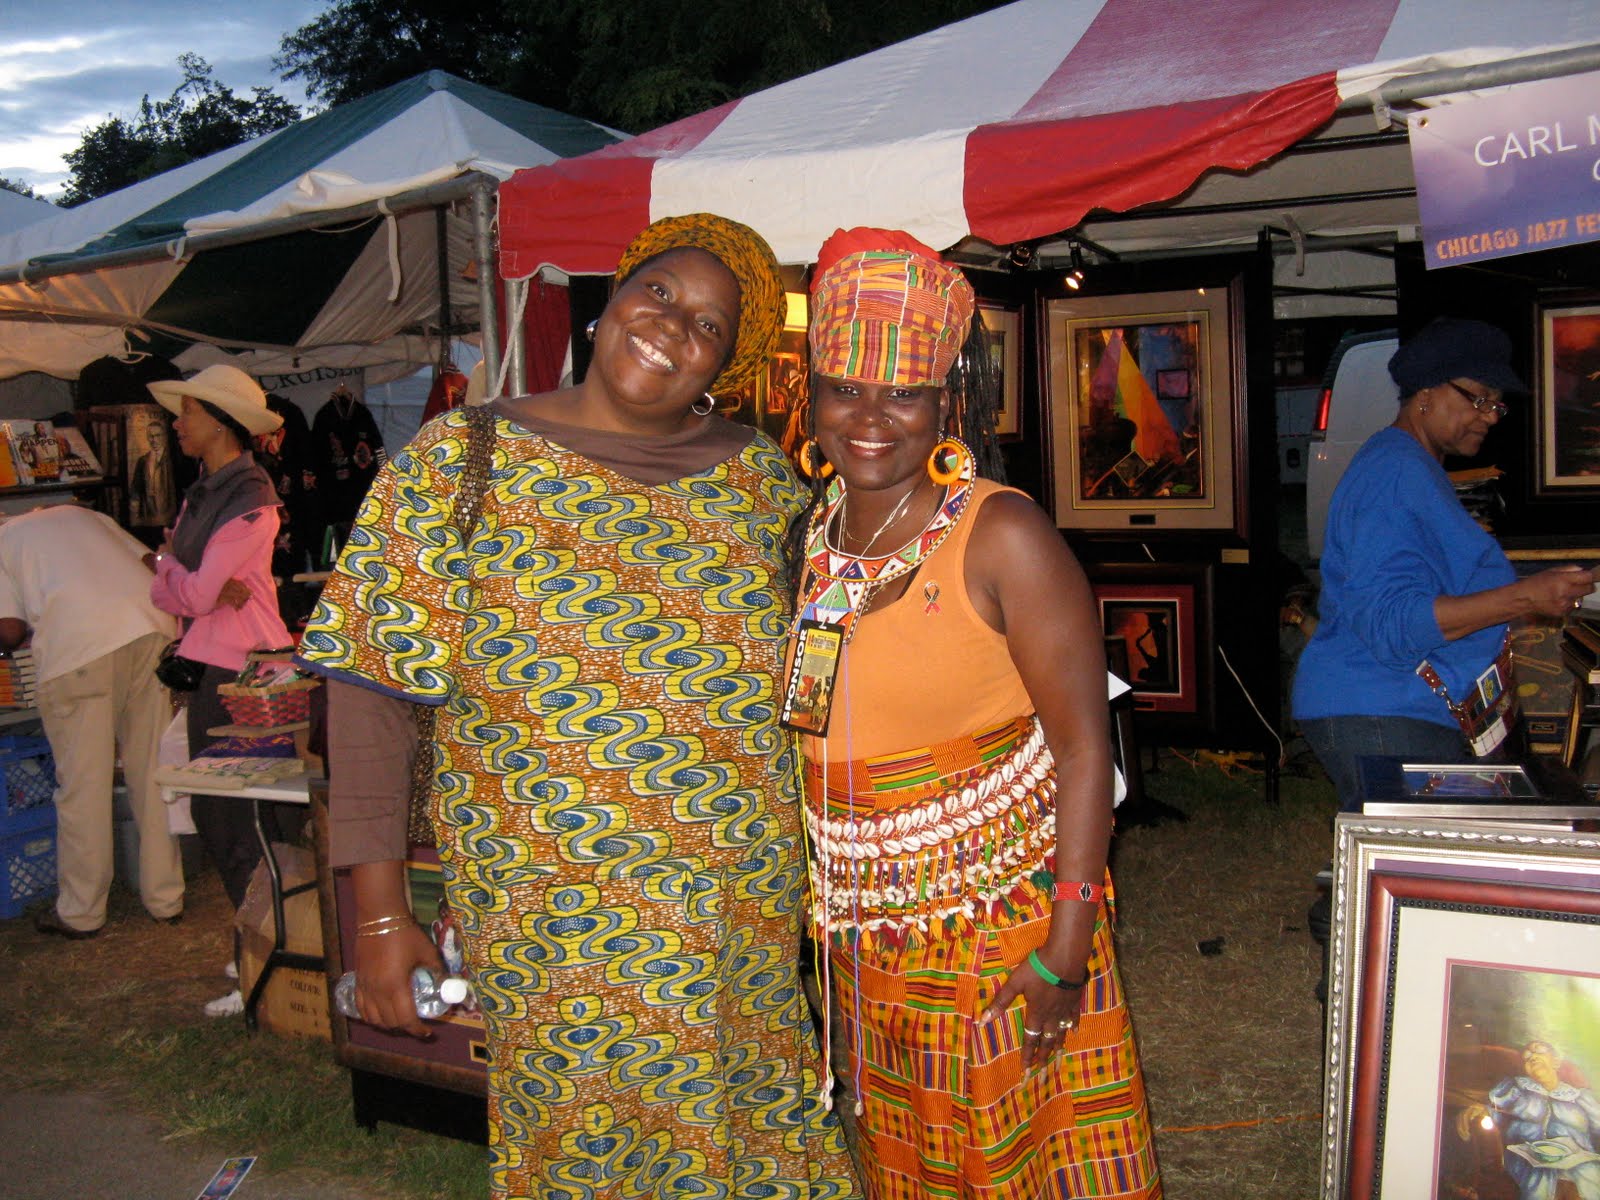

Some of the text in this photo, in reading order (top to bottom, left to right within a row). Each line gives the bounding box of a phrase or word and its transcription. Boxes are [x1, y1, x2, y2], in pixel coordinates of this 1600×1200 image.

[1474, 121, 1578, 167] CARL
[1436, 228, 1520, 260] CHICAGO
[1527, 218, 1569, 244] JAZZ
[782, 629, 808, 722] SPONSOR
